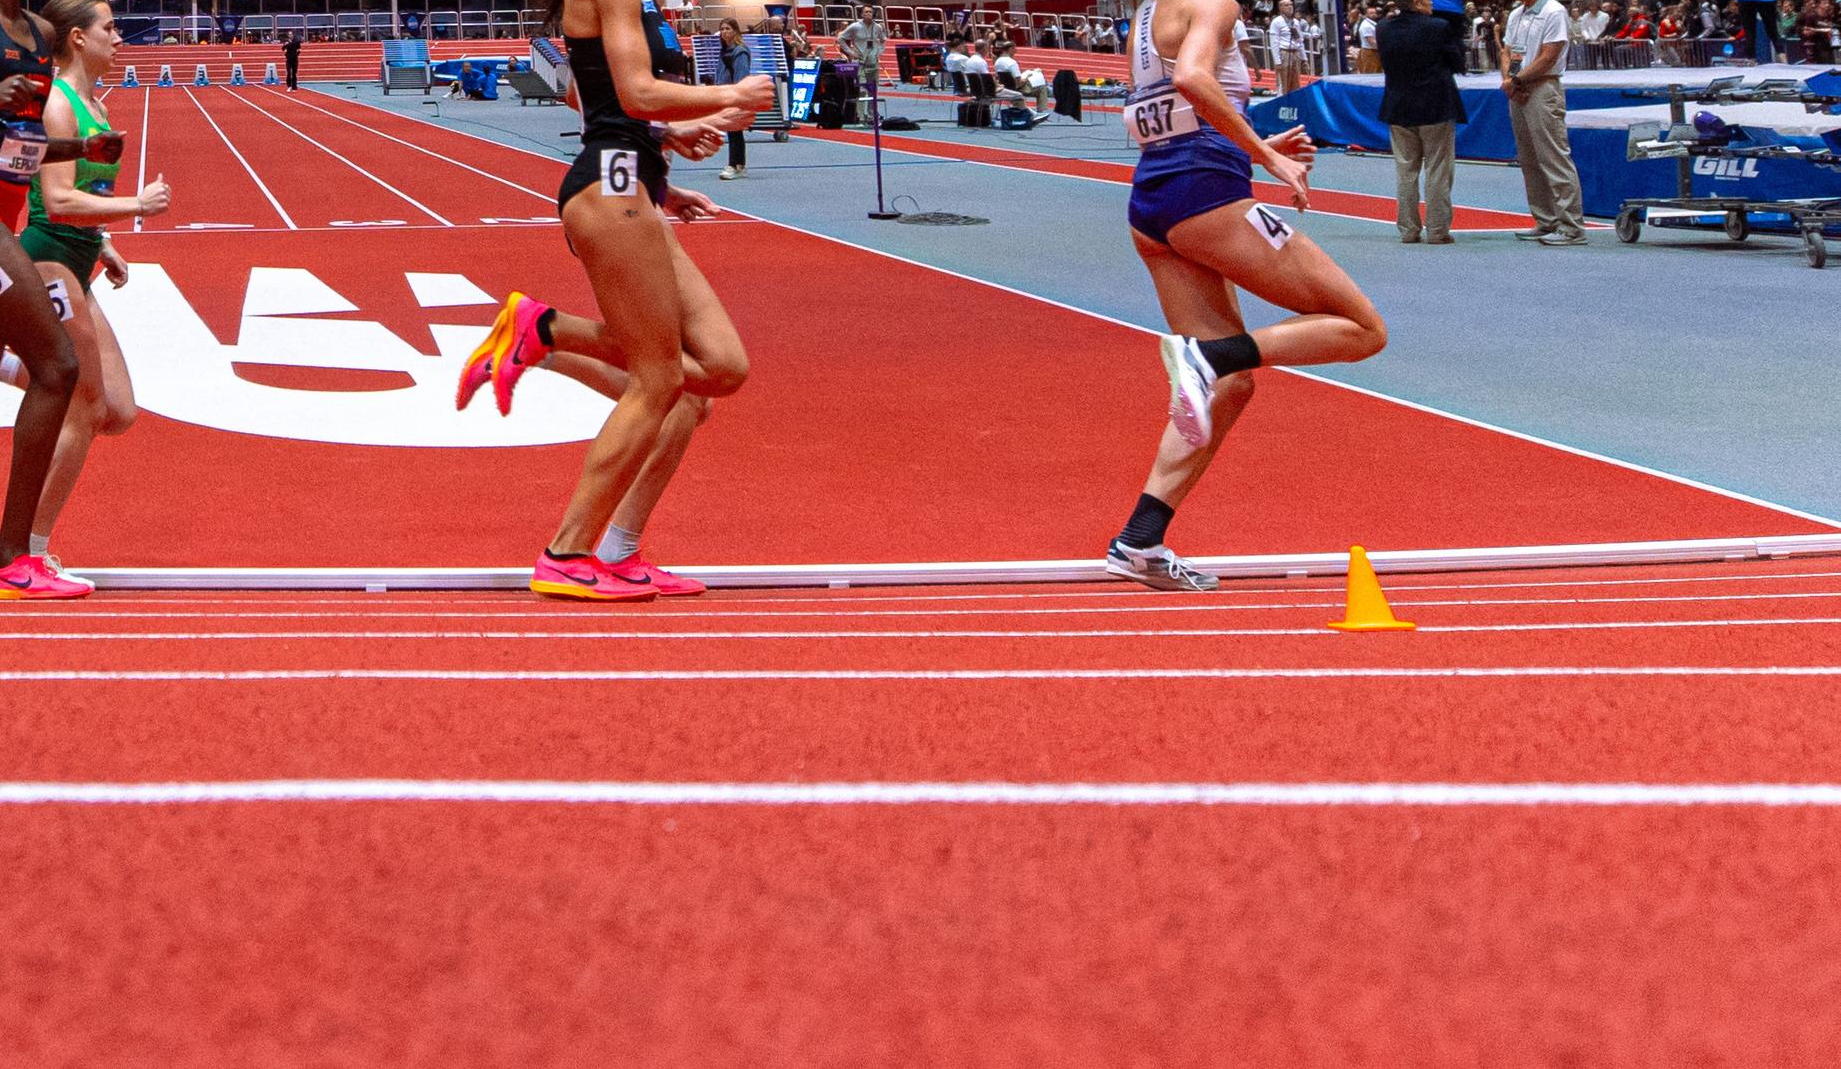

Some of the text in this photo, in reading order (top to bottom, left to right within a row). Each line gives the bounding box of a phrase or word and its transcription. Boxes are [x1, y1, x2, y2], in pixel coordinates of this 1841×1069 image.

[1141, 5, 1151, 70] HUSKIES
[127, 72, 135, 83] 5
[162, 71, 169, 82] 4
[199, 70, 205, 80] 3
[234, 70, 241, 81] 2
[269, 69, 275, 79] 1
[1135, 98, 1175, 138] 637
[609, 152, 630, 193] 6
[1693, 156, 1759, 177] GILL
[1256, 207, 1289, 238] 4
[47, 283, 65, 319] 5
